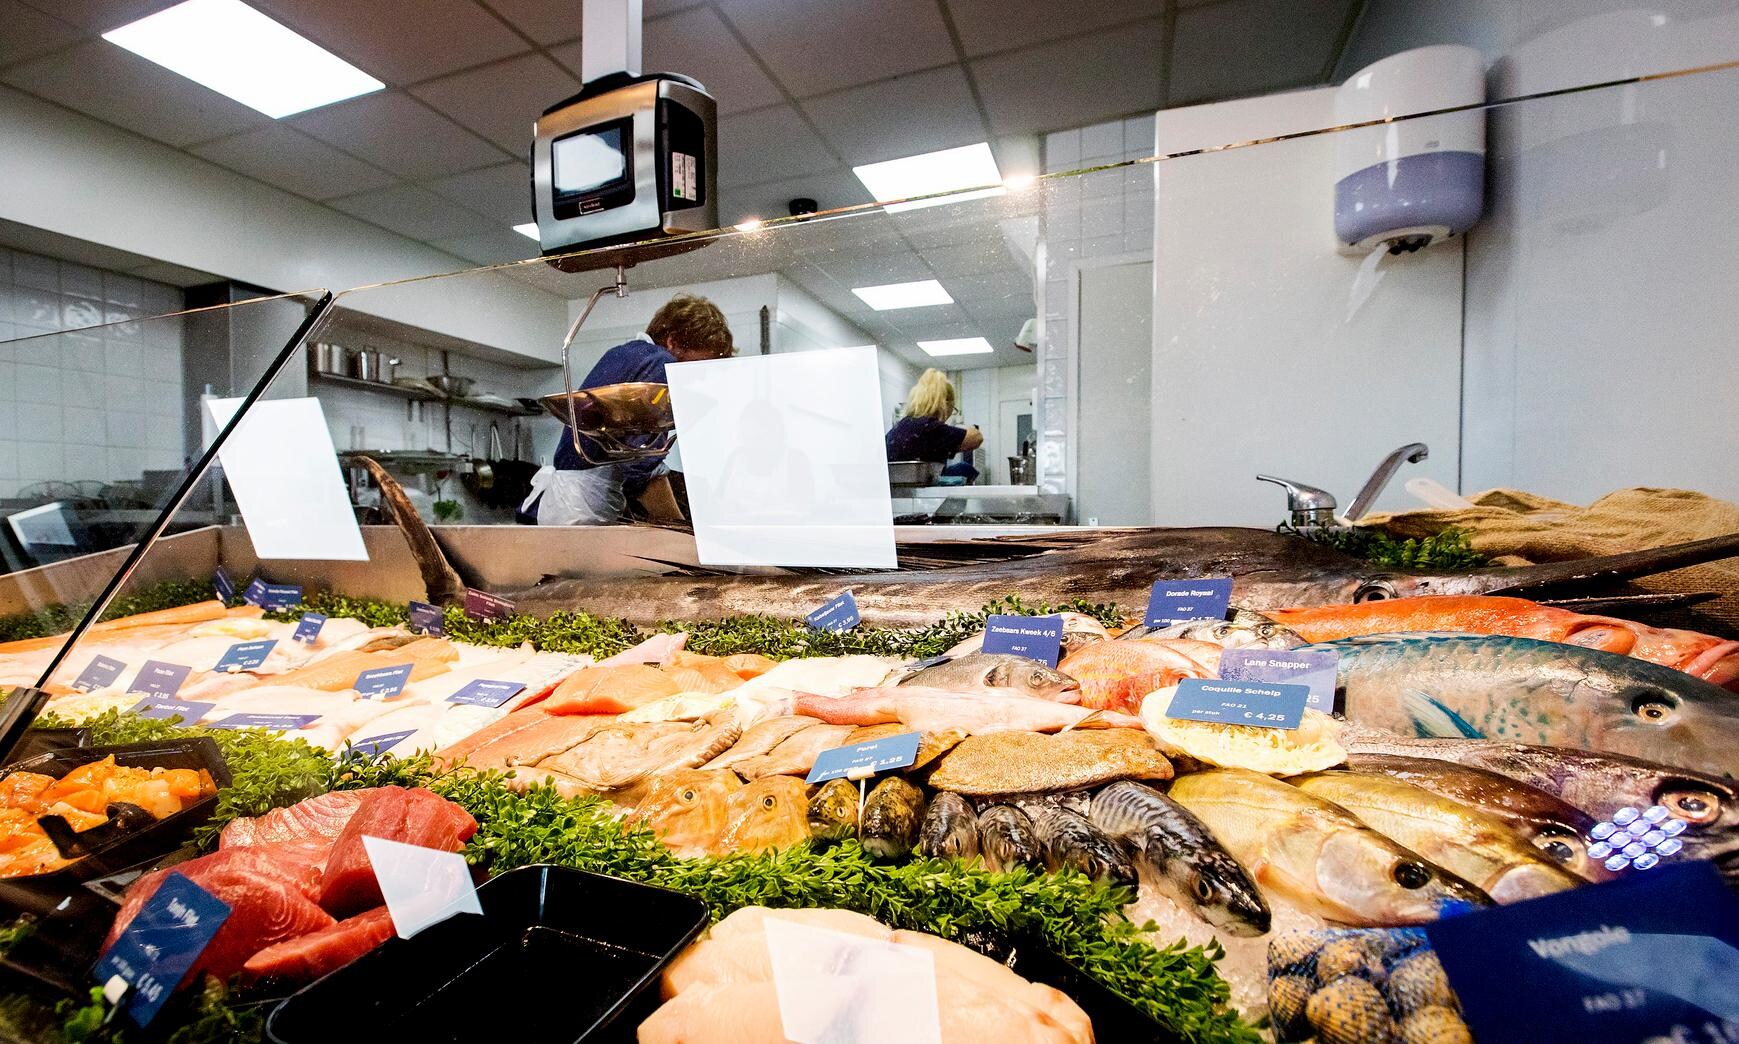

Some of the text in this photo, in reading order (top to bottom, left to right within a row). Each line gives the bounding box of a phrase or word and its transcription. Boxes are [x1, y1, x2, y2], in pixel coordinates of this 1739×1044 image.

[1190, 589, 1214, 598] Royaal
[991, 625, 1056, 638] Zeebaars Kweek 4/6
[1244, 658, 1311, 670] Lane Snapper
[1201, 685, 1282, 697] Coquille Schelp
[1243, 711, 1286, 722] € 4,25
